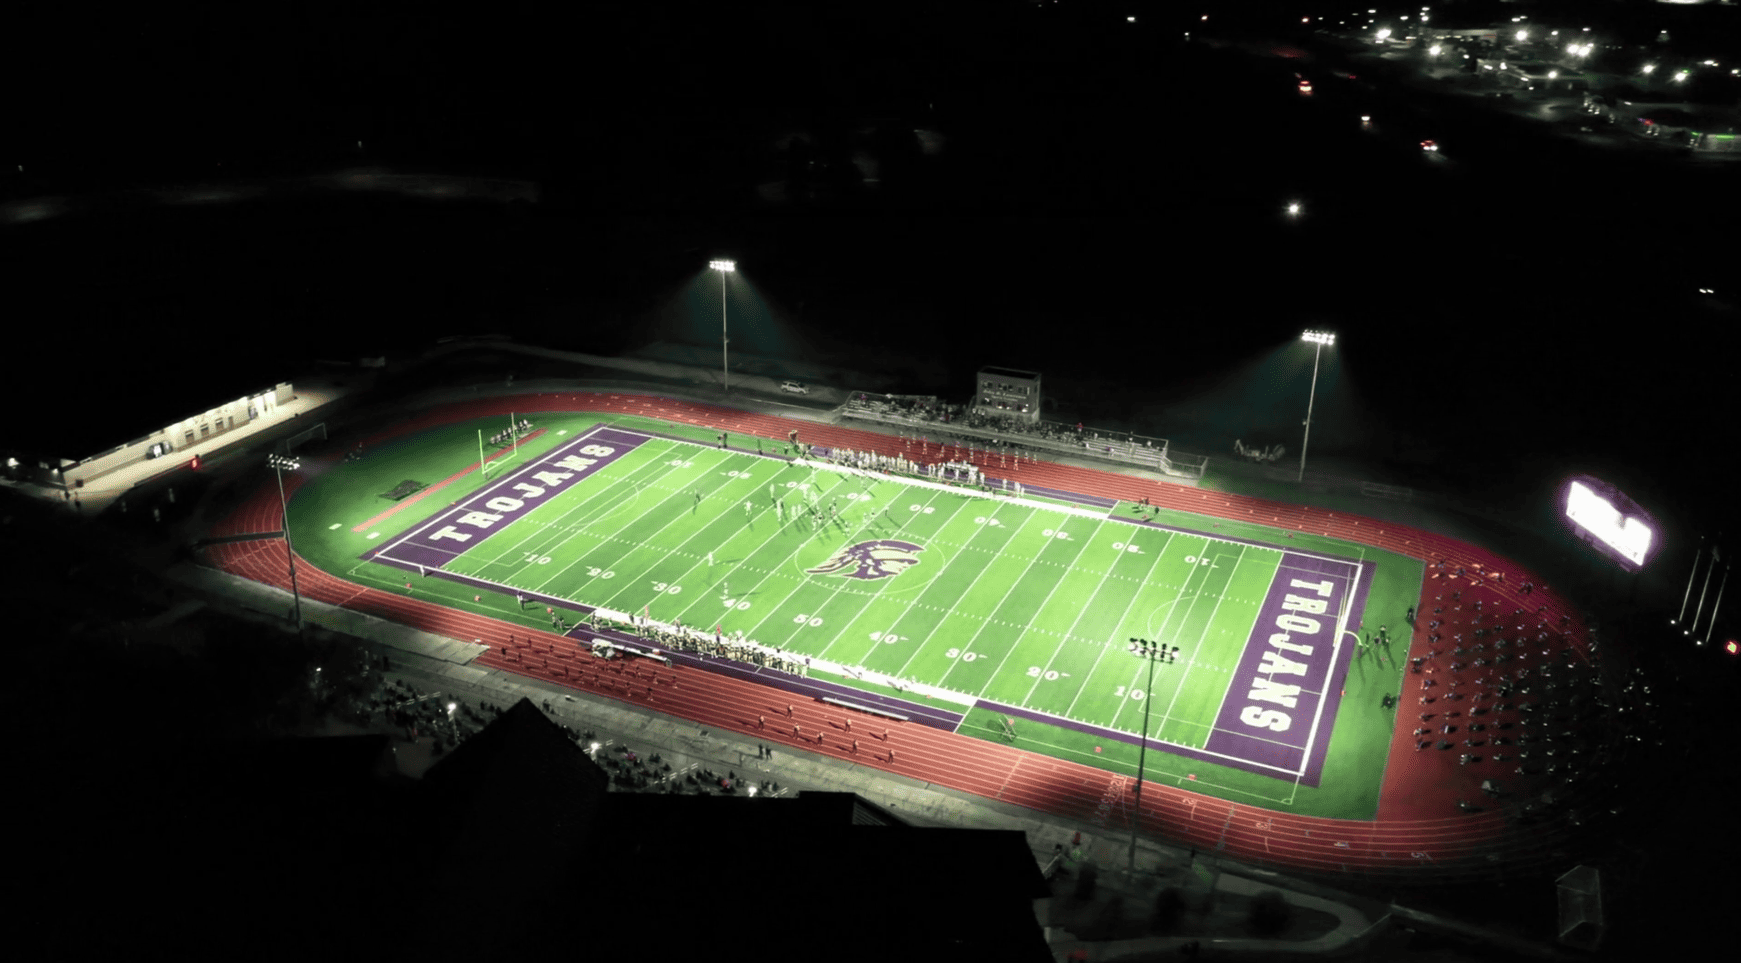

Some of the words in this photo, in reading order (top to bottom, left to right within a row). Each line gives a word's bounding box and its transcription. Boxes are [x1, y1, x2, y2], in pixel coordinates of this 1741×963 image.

[428, 444, 616, 542] TROJANS
[525, 553, 552, 565] 10
[652, 582, 682, 595] 30
[793, 613, 823, 628] 50
[868, 630, 898, 645] 40
[945, 647, 977, 663] 30
[1239, 579, 1334, 732] TROJANS
[1025, 666, 1060, 681] 20
[1113, 685, 1145, 701] 10
